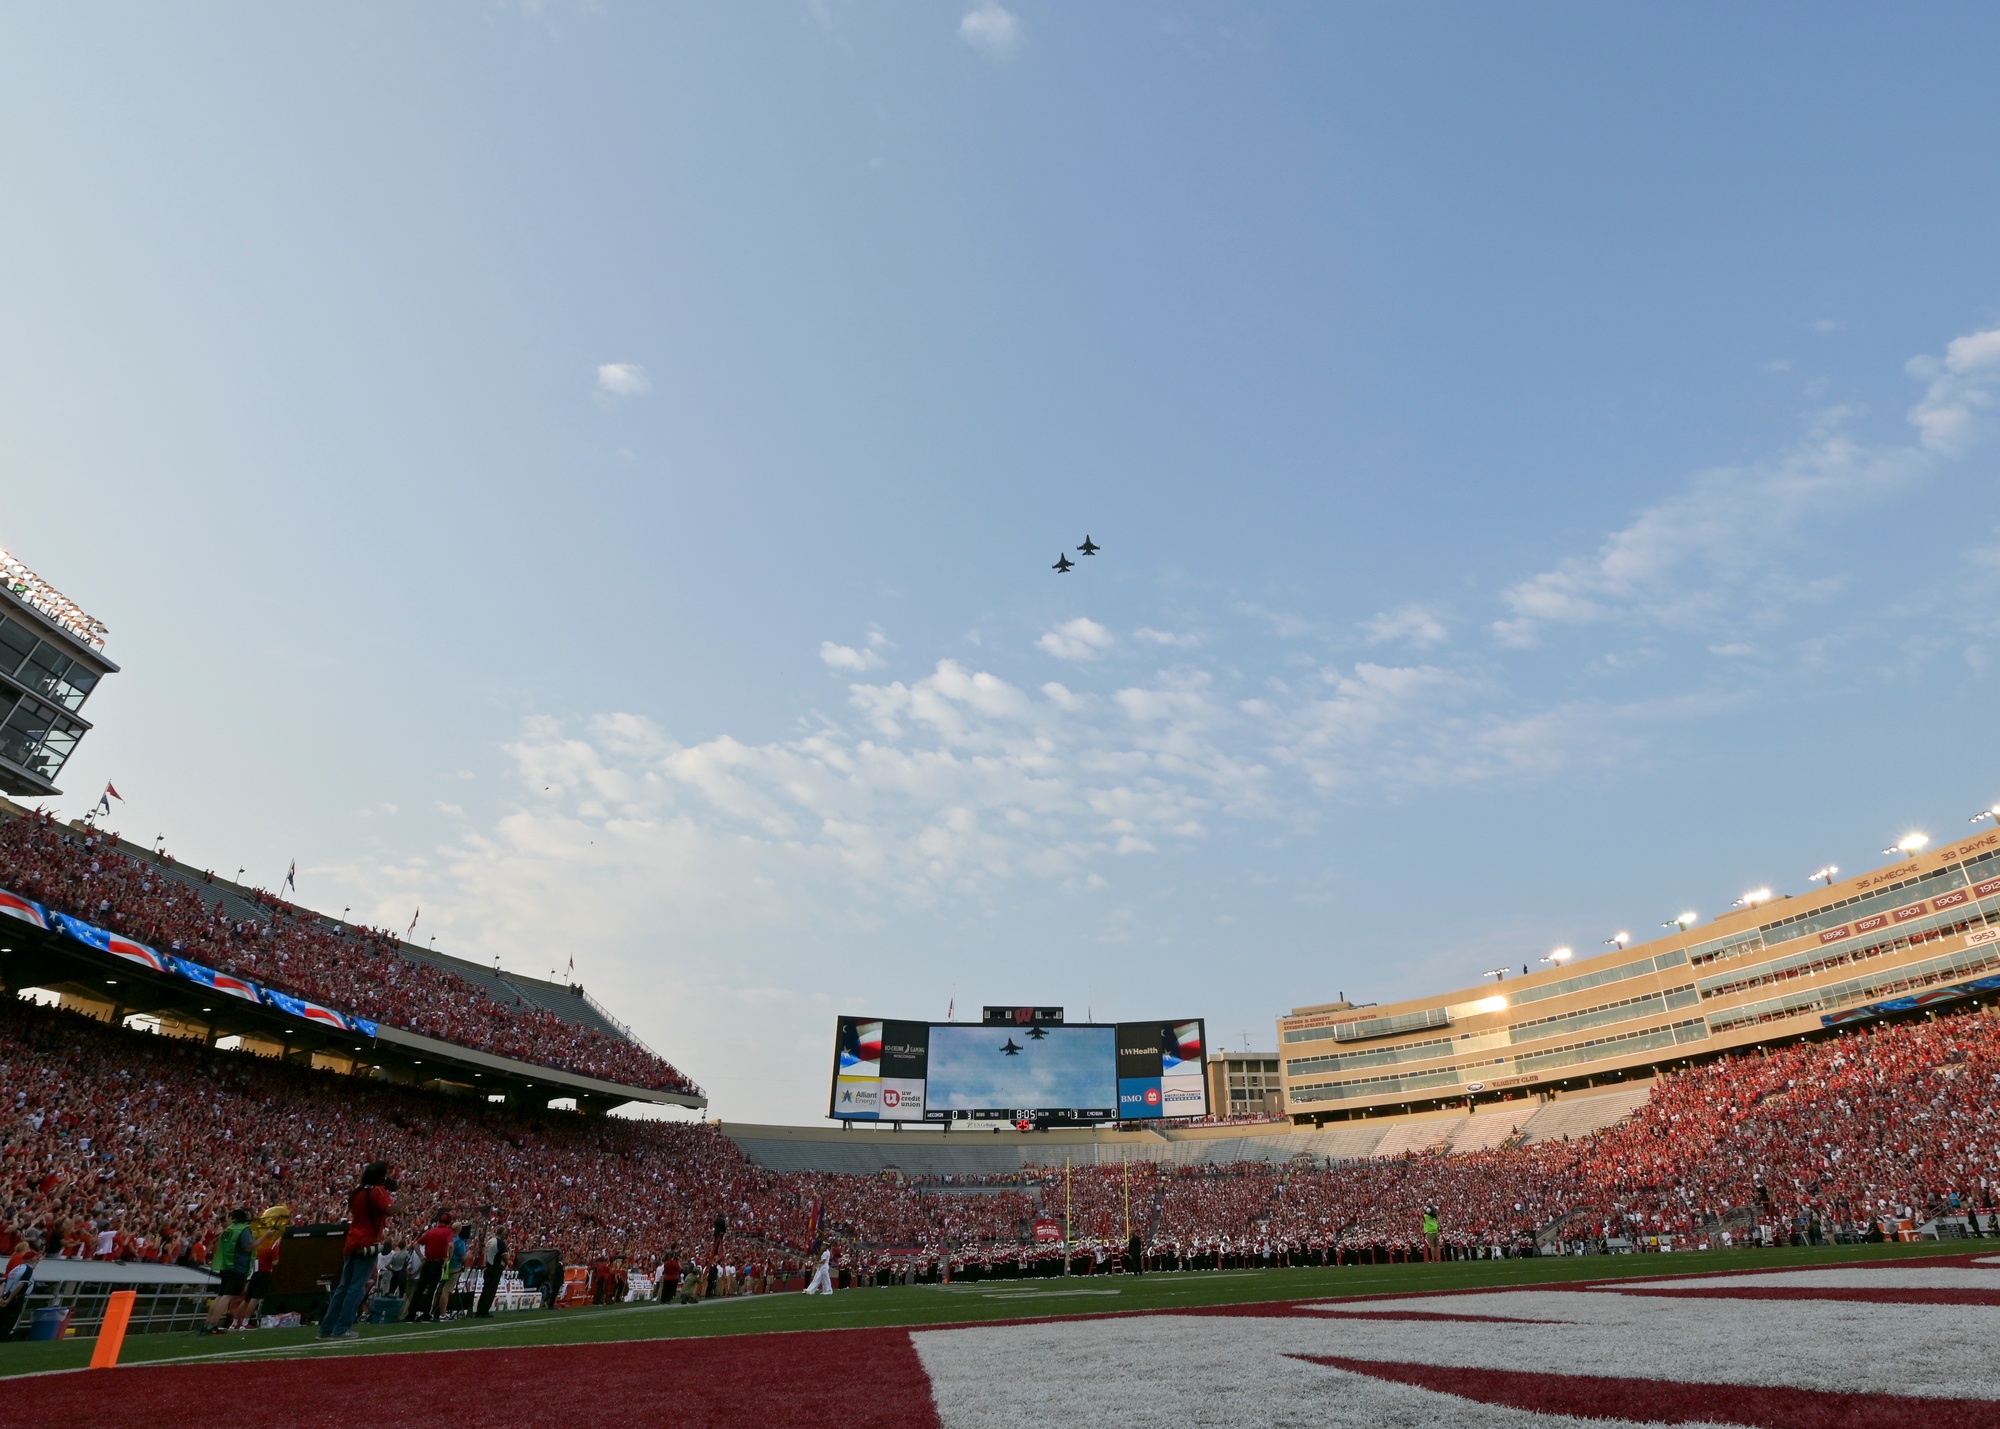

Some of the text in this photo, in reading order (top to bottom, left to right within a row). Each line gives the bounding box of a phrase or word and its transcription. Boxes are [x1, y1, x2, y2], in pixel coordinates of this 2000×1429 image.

[1940, 835, 1998, 862] 33 DAYNE
[1856, 864, 1920, 890] 35 AMECHE
[1979, 881, 2000, 893] 1912
[1935, 894, 1963, 907] 1906
[1898, 907, 1920, 918] 1901
[1859, 918, 1881, 930] 1897
[1822, 929, 1845, 941] 1896
[1970, 930, 1996, 943] 1953
[1014, 1007, 1034, 1024] W
[1326, 1017, 1358, 1025] PERFORMANCE
[1492, 1078, 1520, 1087] VARSITY
[1521, 1075, 1538, 1083] CLUB
[952, 1110, 958, 1119] 0
[1016, 1110, 1036, 1119] 8:05
[1111, 1109, 1116, 1118] 0
[1017, 1120, 1029, 1131] 25
